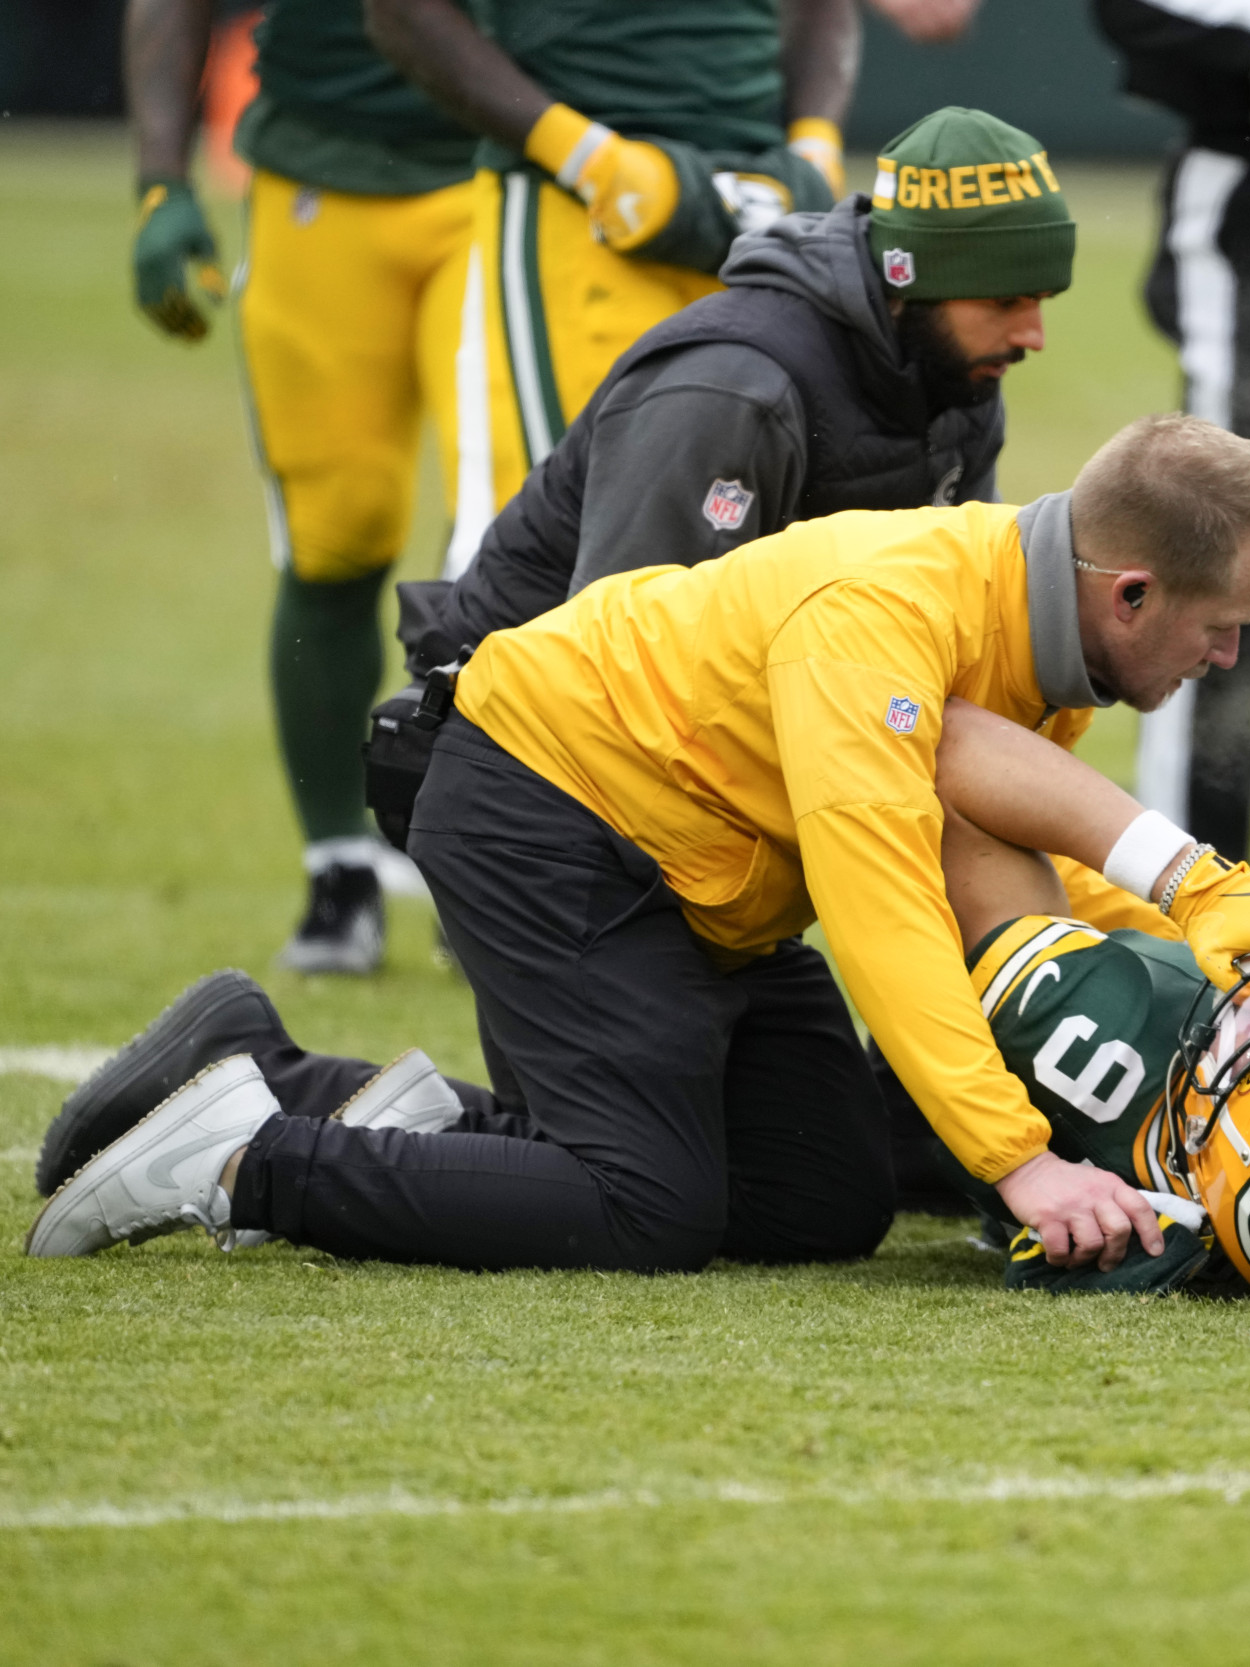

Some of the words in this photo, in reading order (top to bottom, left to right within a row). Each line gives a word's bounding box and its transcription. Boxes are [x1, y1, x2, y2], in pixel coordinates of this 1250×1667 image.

[897, 159, 1042, 209] GREEN
[709, 495, 739, 522] NFL
[889, 709, 912, 729] NFL
[1032, 1013, 1146, 1124] 9
